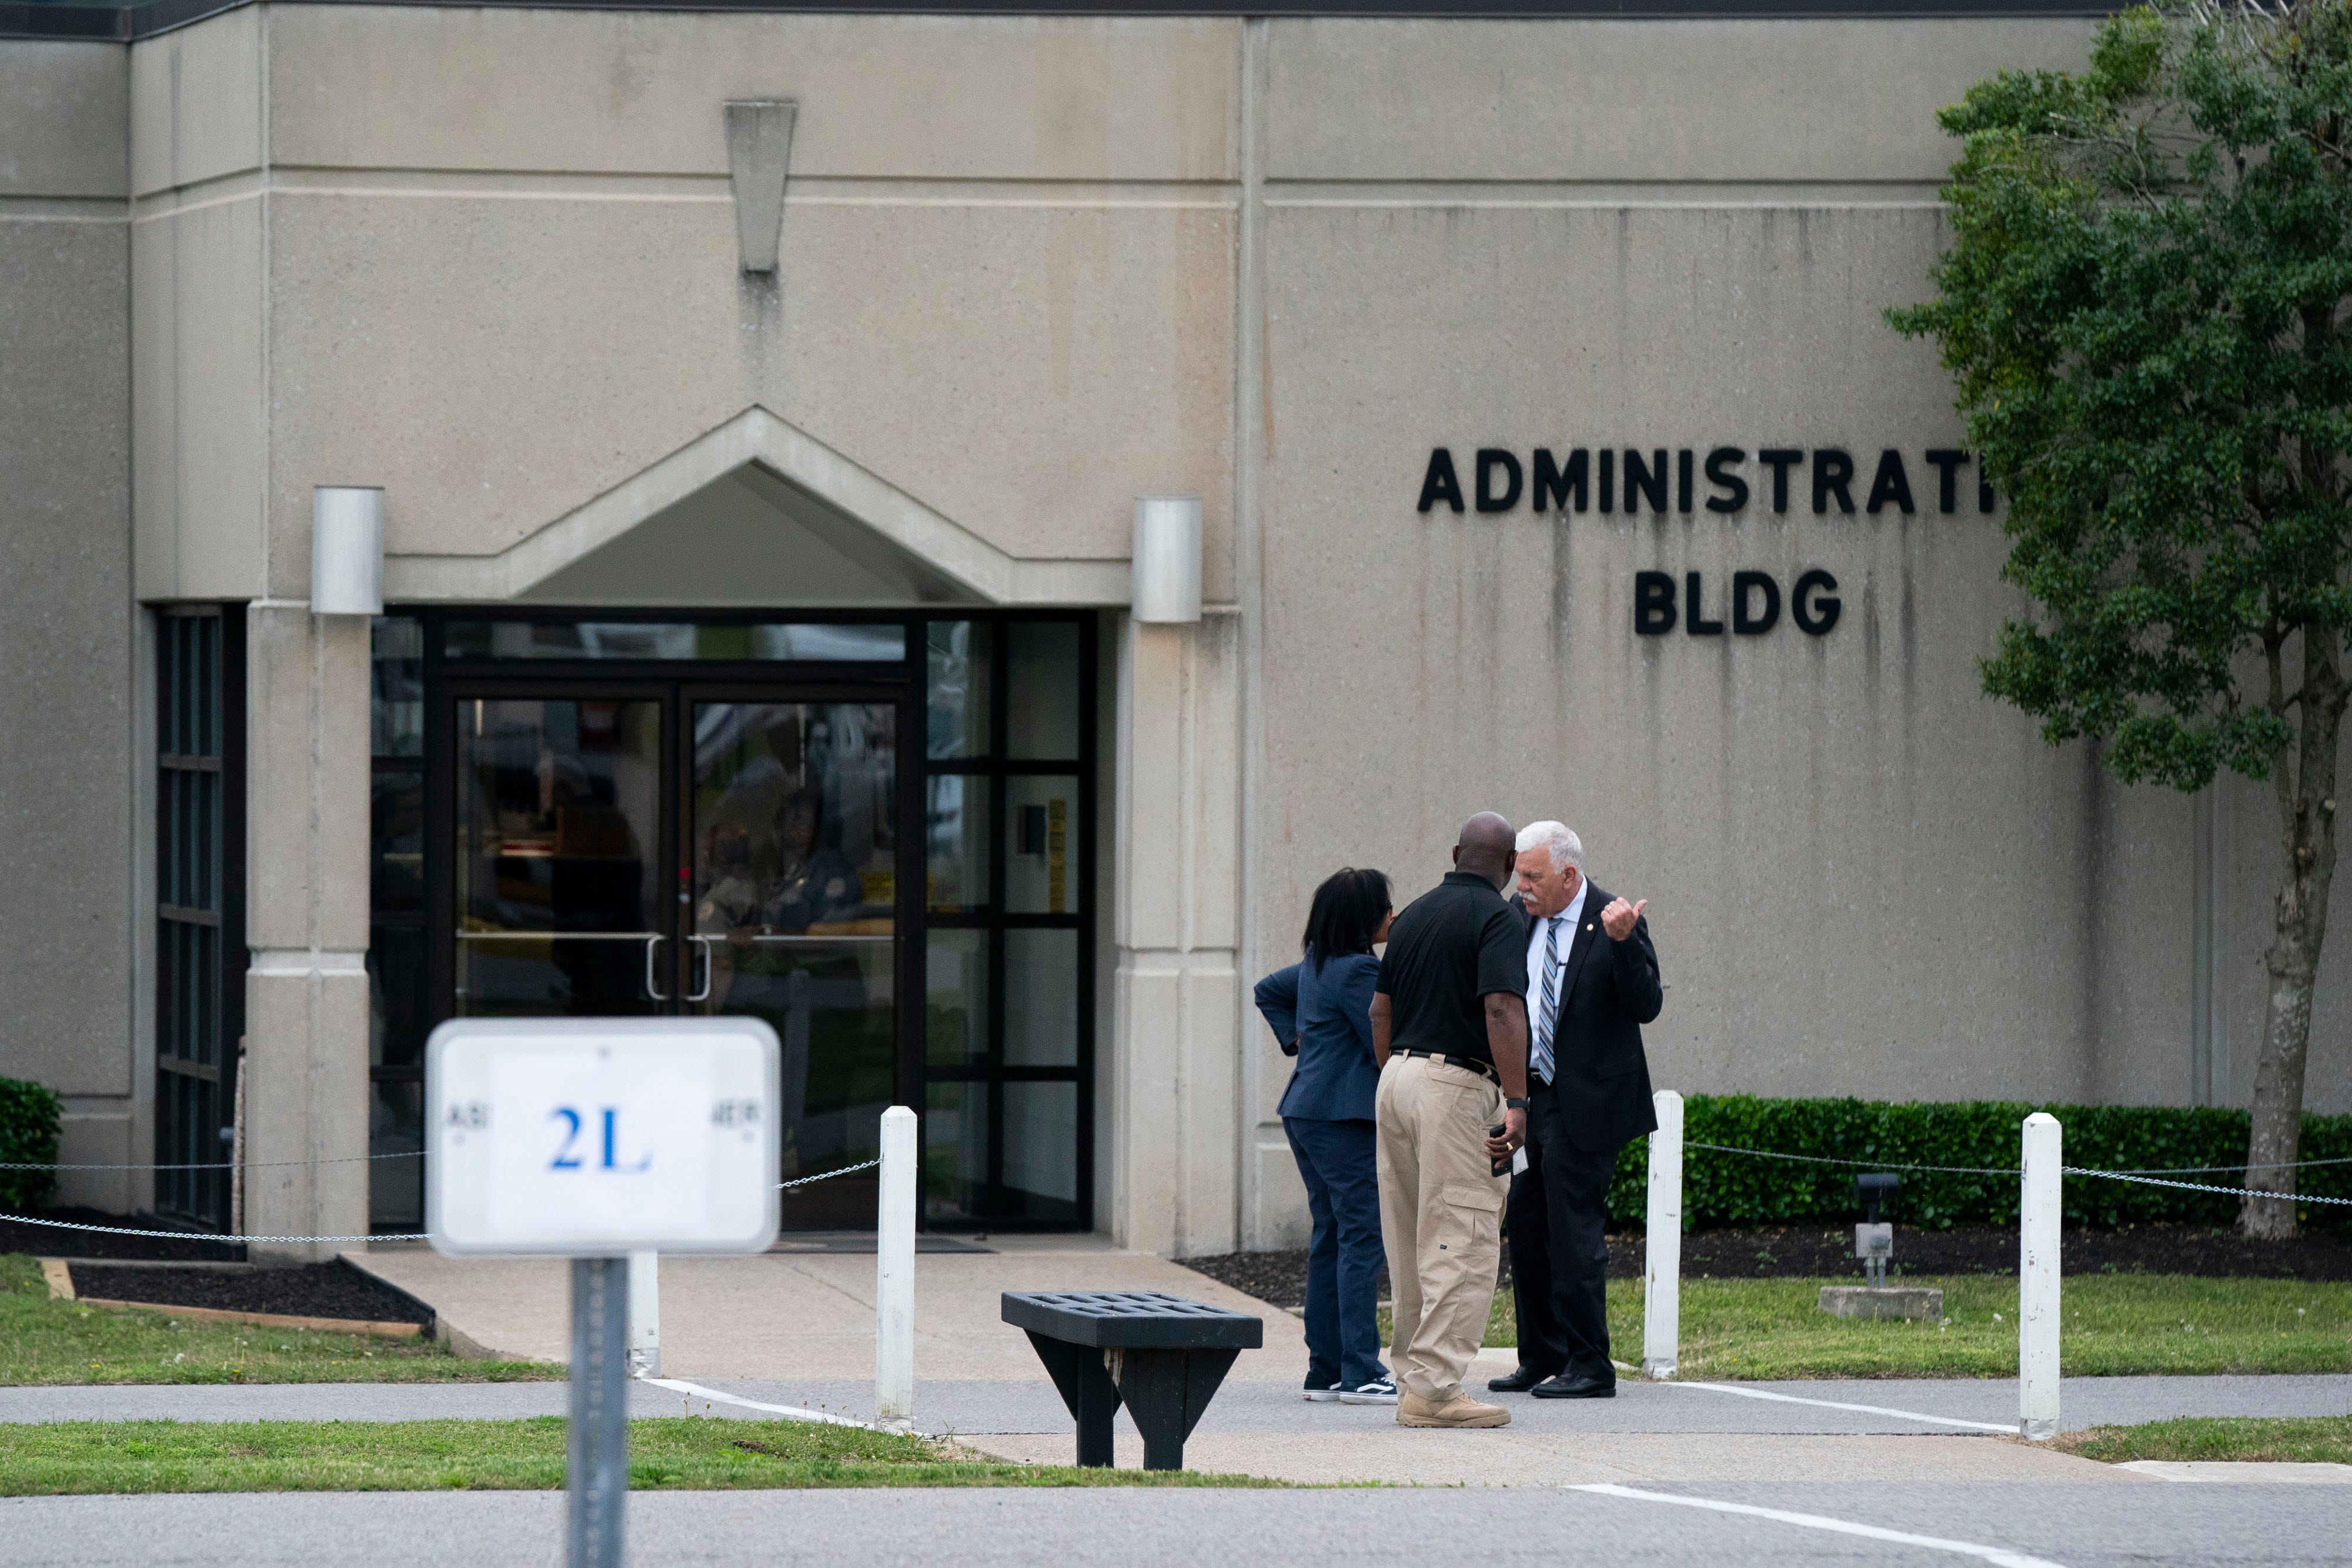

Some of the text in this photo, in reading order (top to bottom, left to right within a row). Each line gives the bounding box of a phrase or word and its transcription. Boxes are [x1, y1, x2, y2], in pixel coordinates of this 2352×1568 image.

[1417, 447, 1994, 513] ADMINISTRATI
[1634, 569, 1841, 636] BLDG
[547, 1104, 651, 1171] 2L
